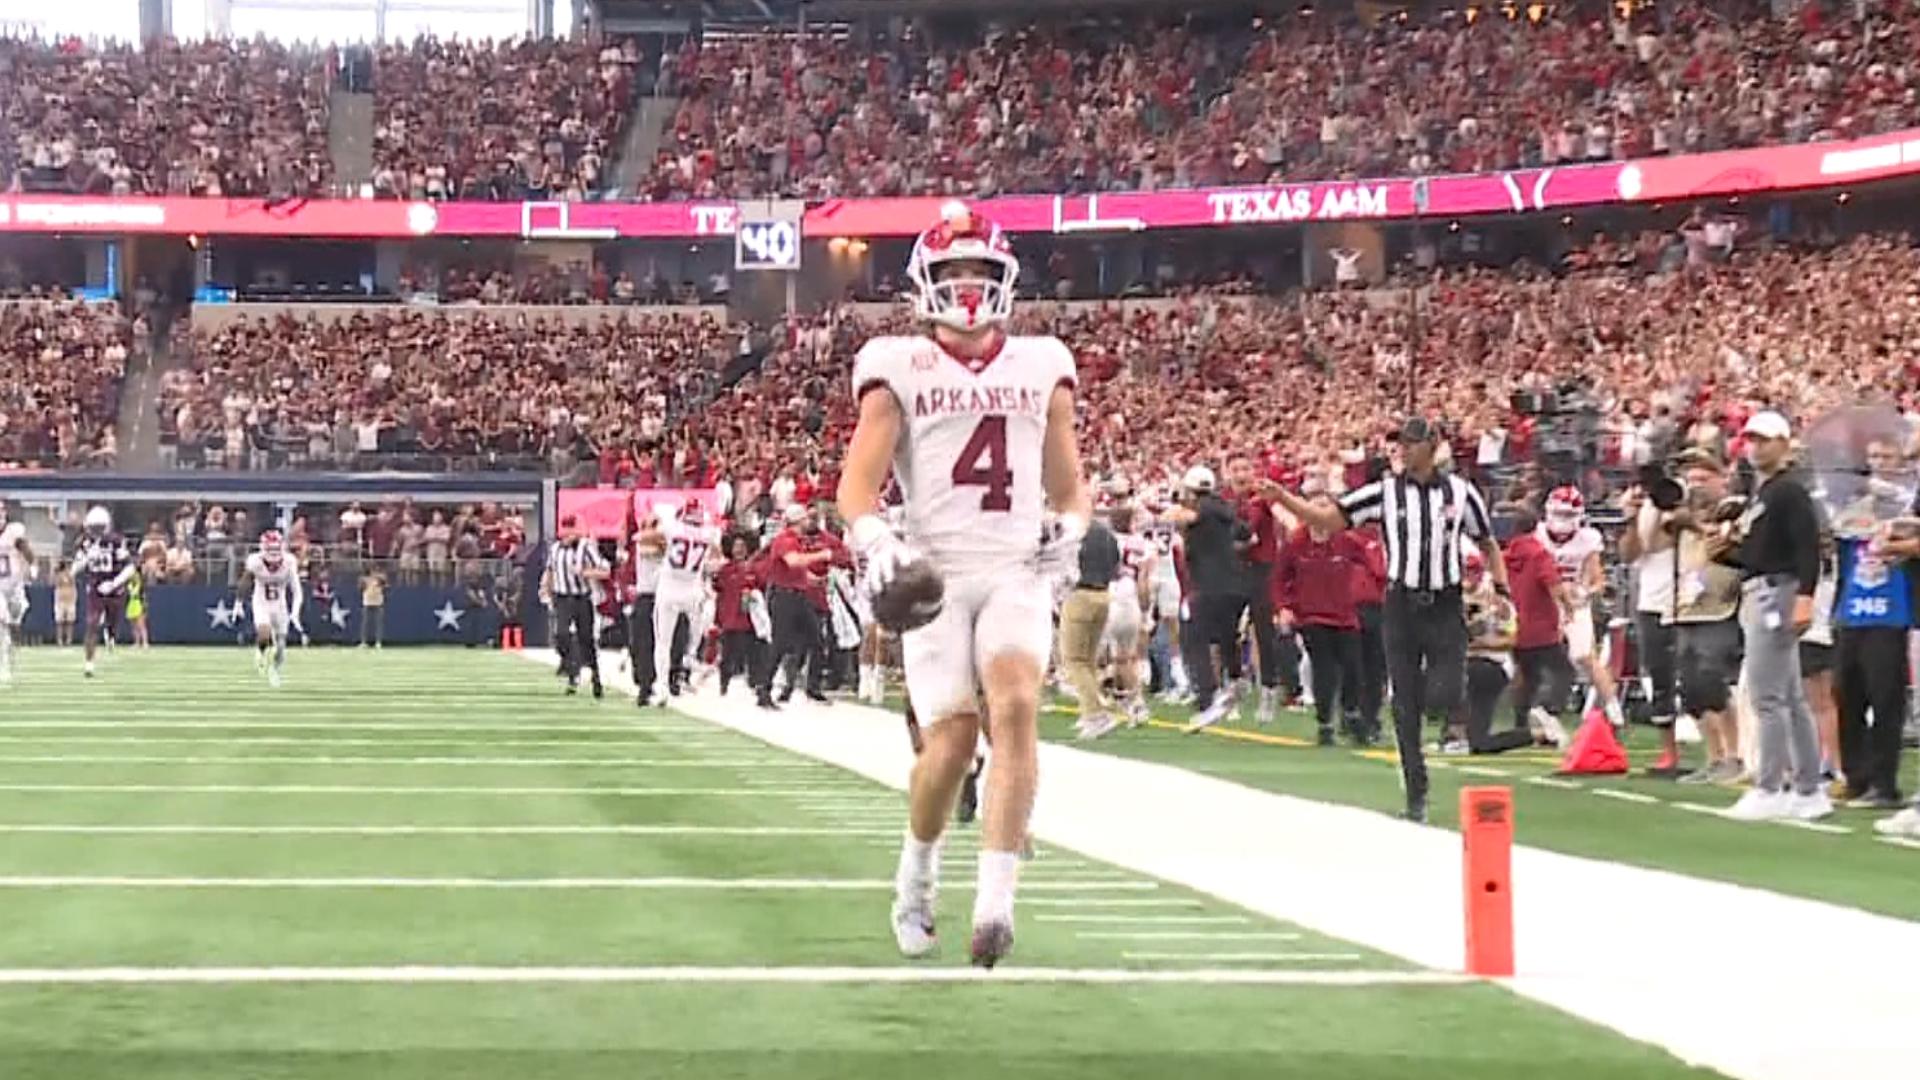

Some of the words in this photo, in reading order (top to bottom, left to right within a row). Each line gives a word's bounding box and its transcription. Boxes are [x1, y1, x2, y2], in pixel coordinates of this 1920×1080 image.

[1208, 187, 1312, 222] TEXAS
[1318, 185, 1388, 218] A&M
[742, 221, 795, 265] 40
[915, 385, 1043, 416] ARKANSAS
[952, 413, 1014, 512] 4
[668, 537, 708, 572] 37
[264, 581, 279, 601] 6
